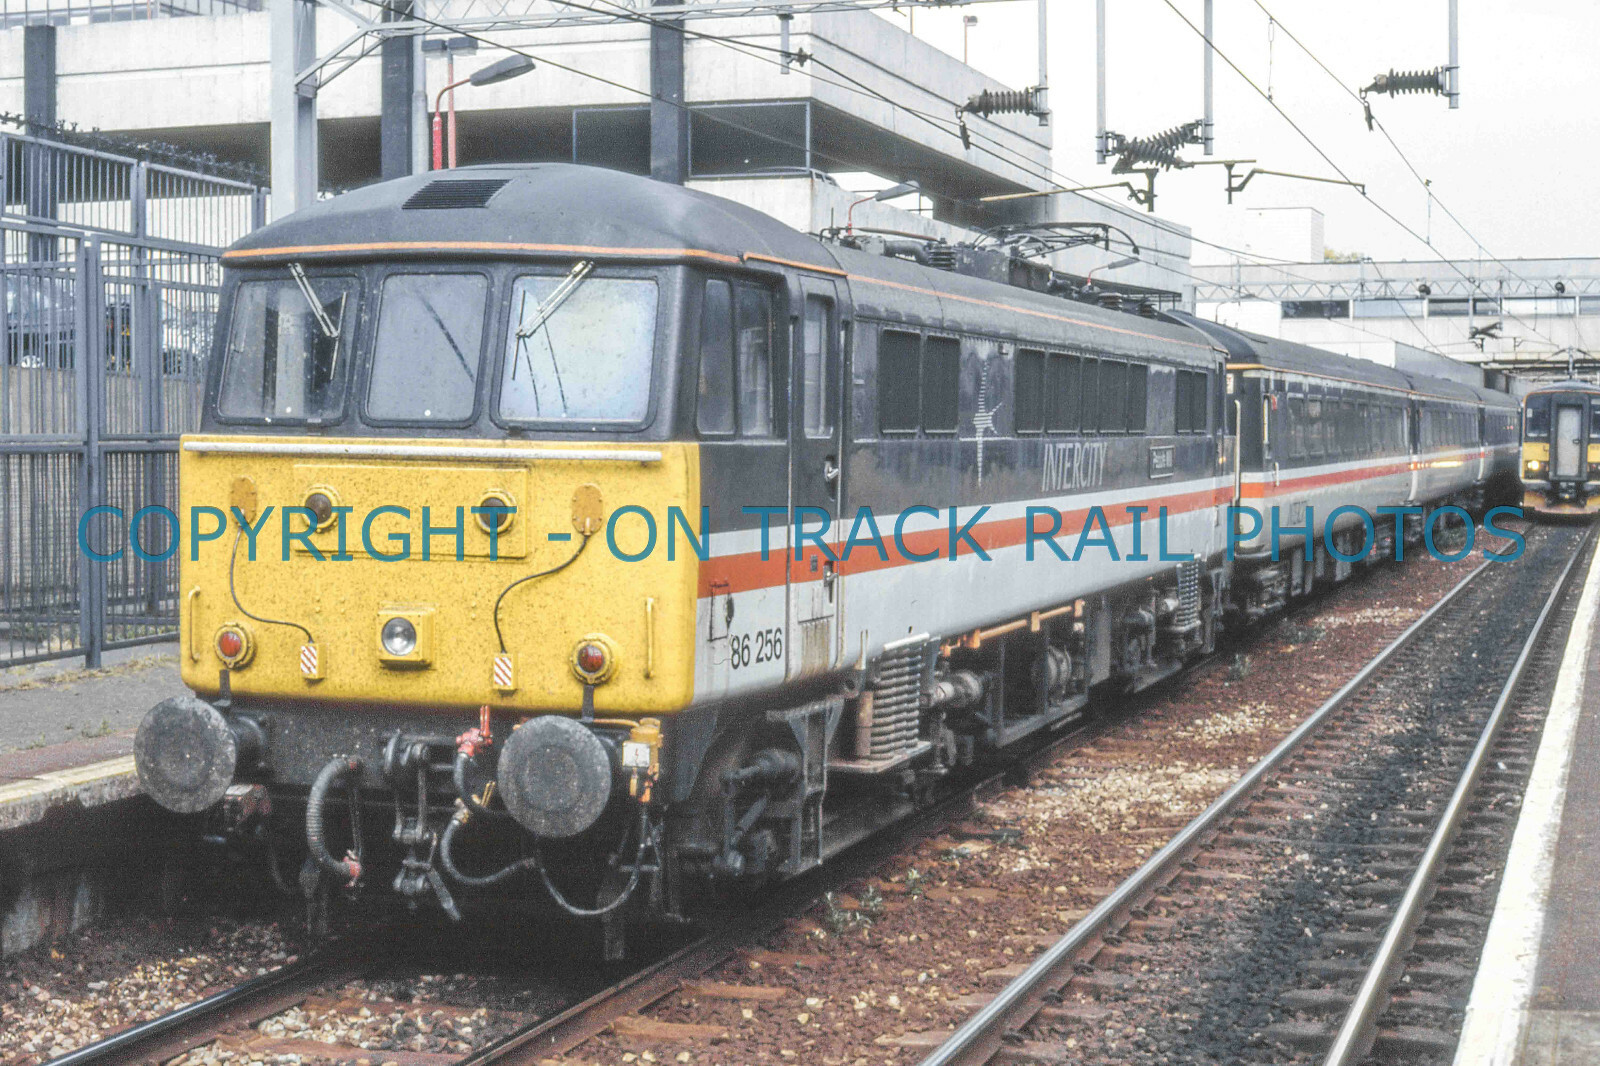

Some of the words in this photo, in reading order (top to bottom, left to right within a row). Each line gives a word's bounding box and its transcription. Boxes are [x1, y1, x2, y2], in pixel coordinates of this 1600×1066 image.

[1042, 442, 1107, 492] INTERCITY
[730, 633, 751, 670] 86
[755, 627, 783, 663] 256
